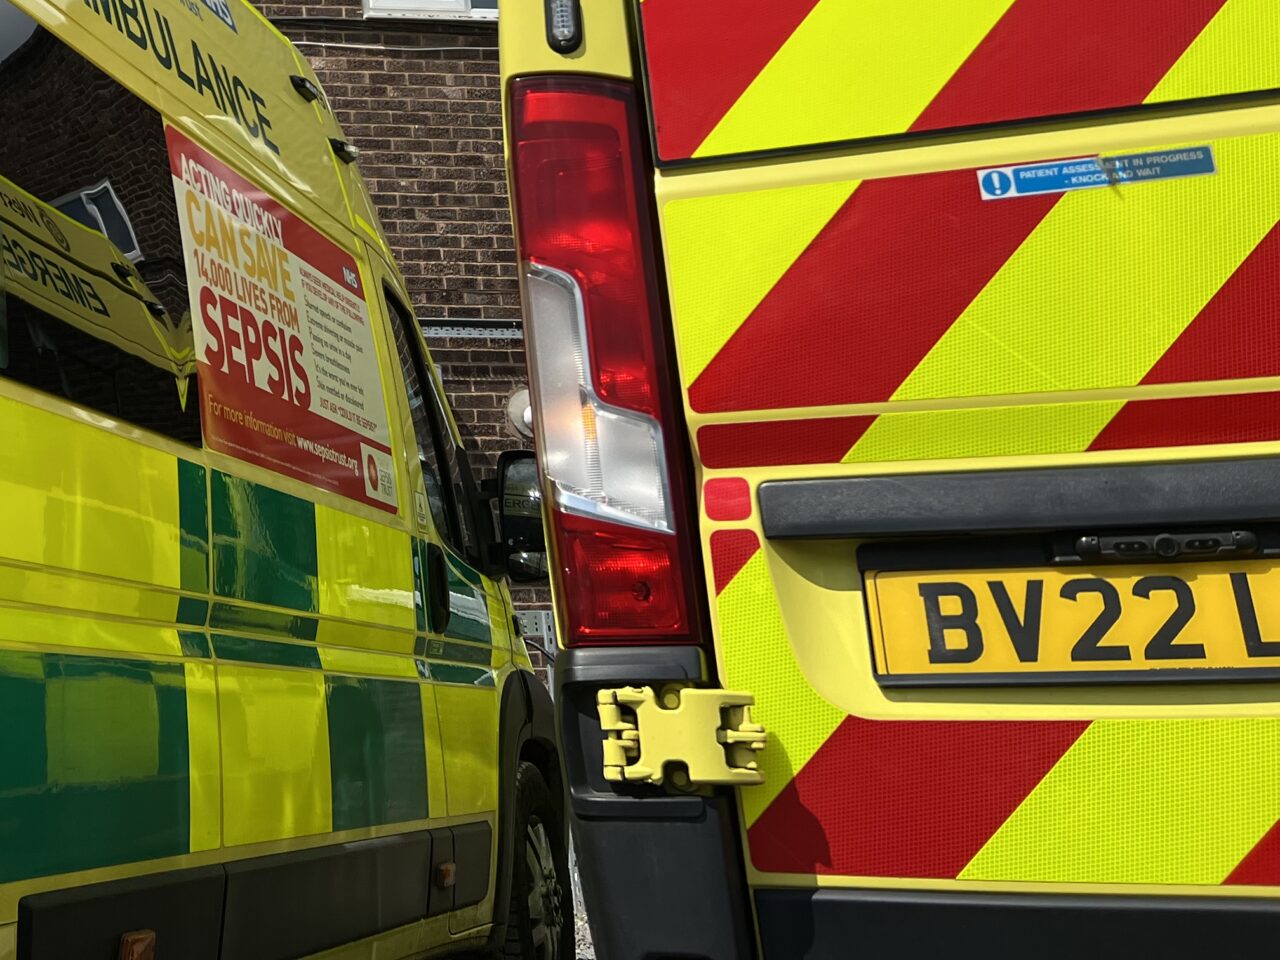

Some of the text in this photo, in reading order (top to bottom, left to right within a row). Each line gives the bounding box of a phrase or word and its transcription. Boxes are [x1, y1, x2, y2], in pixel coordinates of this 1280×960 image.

[181, 153, 283, 244] ACTING QUICKLY
[1019, 166, 1059, 179] PATIENT
[1132, 158, 1144, 167] IN
[1146, 151, 1205, 165] PROGRESS
[1071, 172, 1108, 184] KNOCK
[1111, 169, 1134, 180] AND
[1136, 166, 1162, 177] WAIT
[185, 190, 296, 303] CAN SAVE
[193, 248, 300, 333] 14,000 LIVES FROM
[199, 286, 312, 411] SEPSIS
[208, 394, 221, 418] For
[224, 407, 244, 426] more
[244, 411, 283, 441] information
[283, 429, 297, 448] visit
[296, 434, 359, 477] www.sepsistrust.org
[918, 575, 1207, 664] BV22
